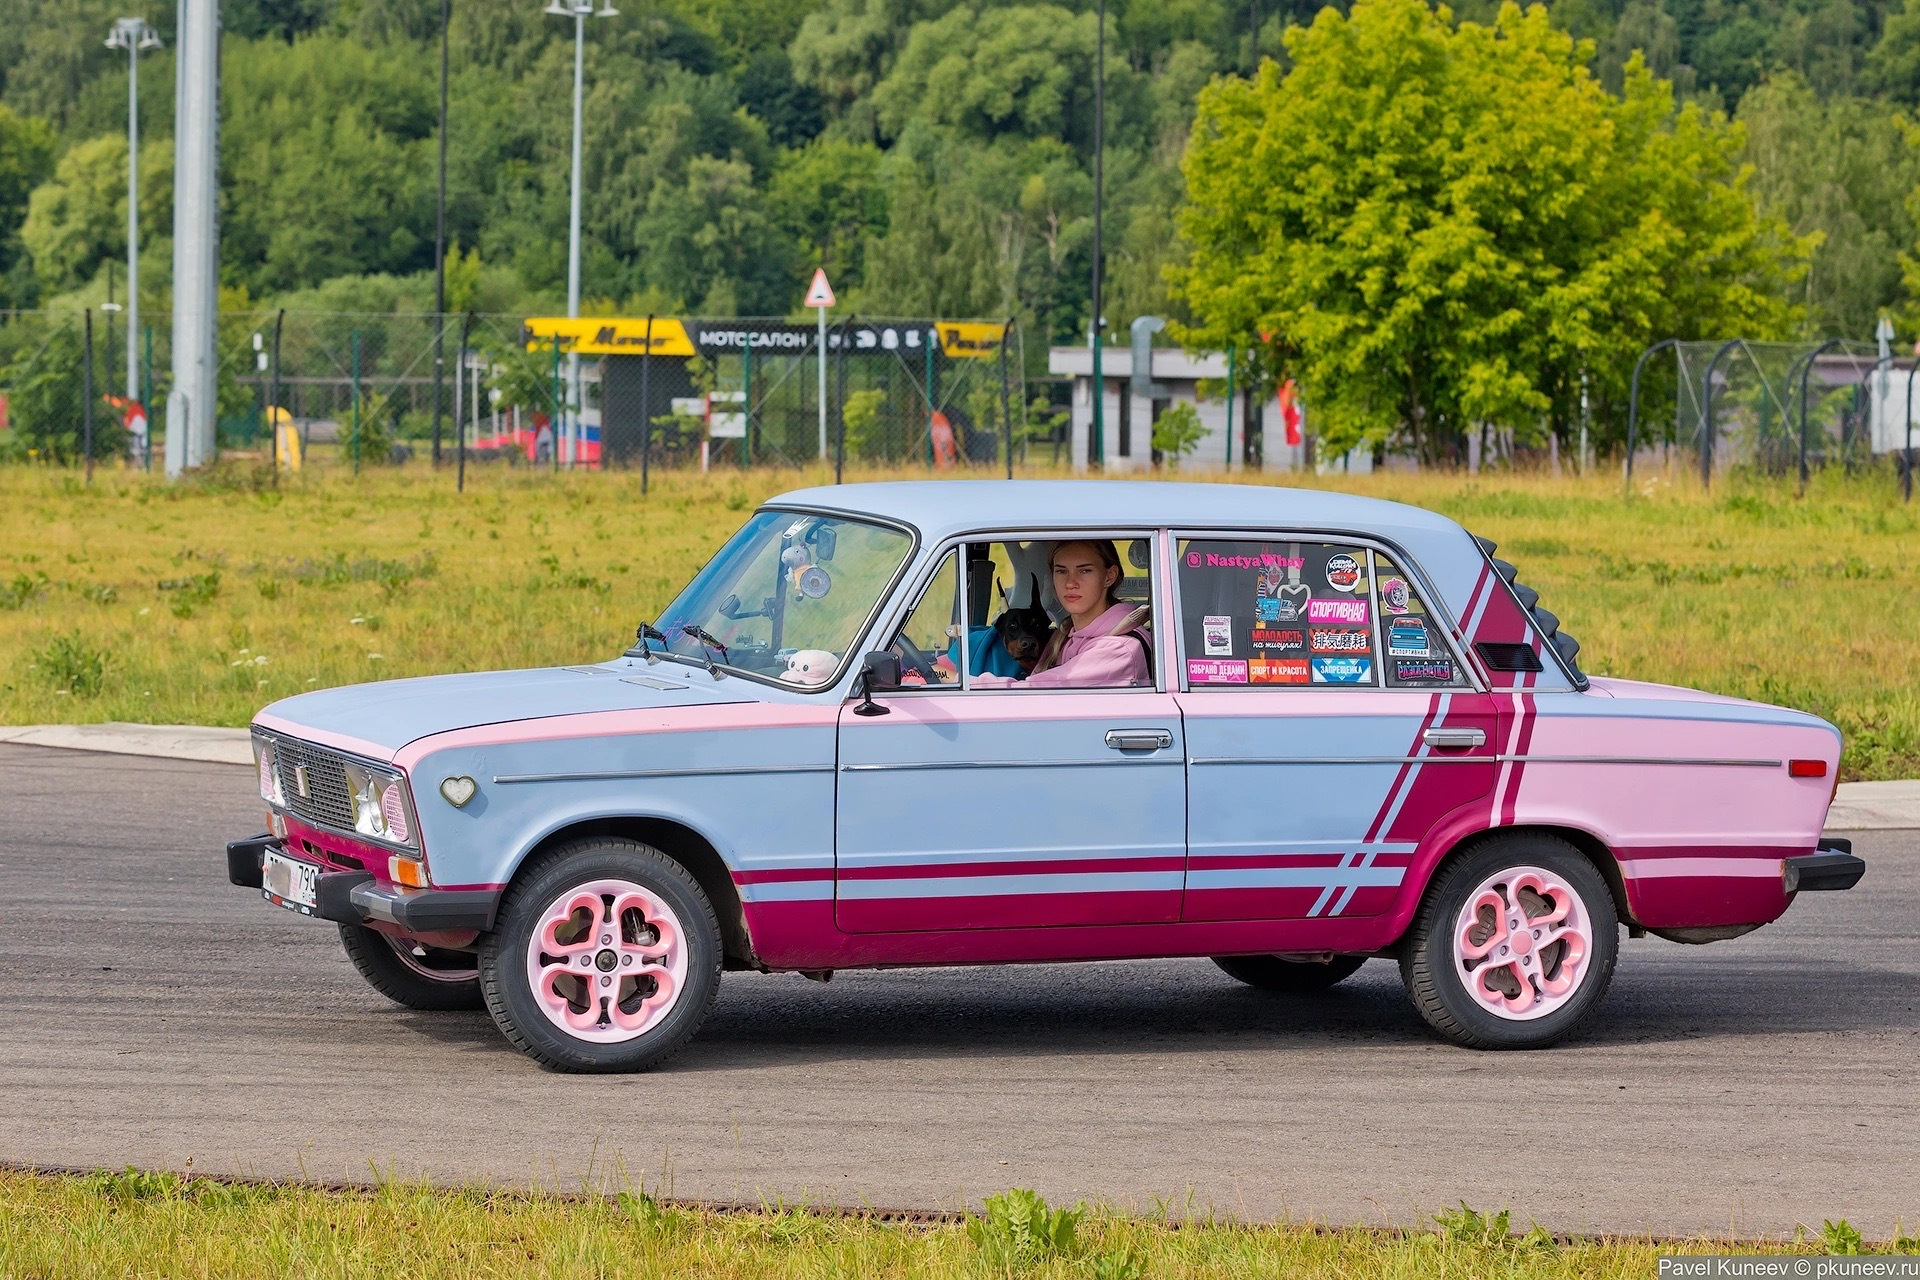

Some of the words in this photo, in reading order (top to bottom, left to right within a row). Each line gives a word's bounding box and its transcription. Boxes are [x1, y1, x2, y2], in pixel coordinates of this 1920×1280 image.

[699, 331, 807, 347] МОТОСАЛОН
[1205, 553, 1305, 570] NastyaWhay
[1310, 602, 1366, 621] СПОРТИВНАЯ
[1251, 630, 1303, 642] МОЛОДОСТЬ
[1264, 641, 1303, 651] жигулях!
[1190, 664, 1217, 675] СОБРАНО
[1219, 664, 1245, 676] ДЕДАМИ
[1250, 666, 1270, 675] СПОРТ
[1272, 666, 1277, 675] И
[1278, 666, 1308, 675] КРАСОТА
[1320, 665, 1363, 676] ЗАПРЕЩЕНКА
[298, 865, 315, 892] 790
